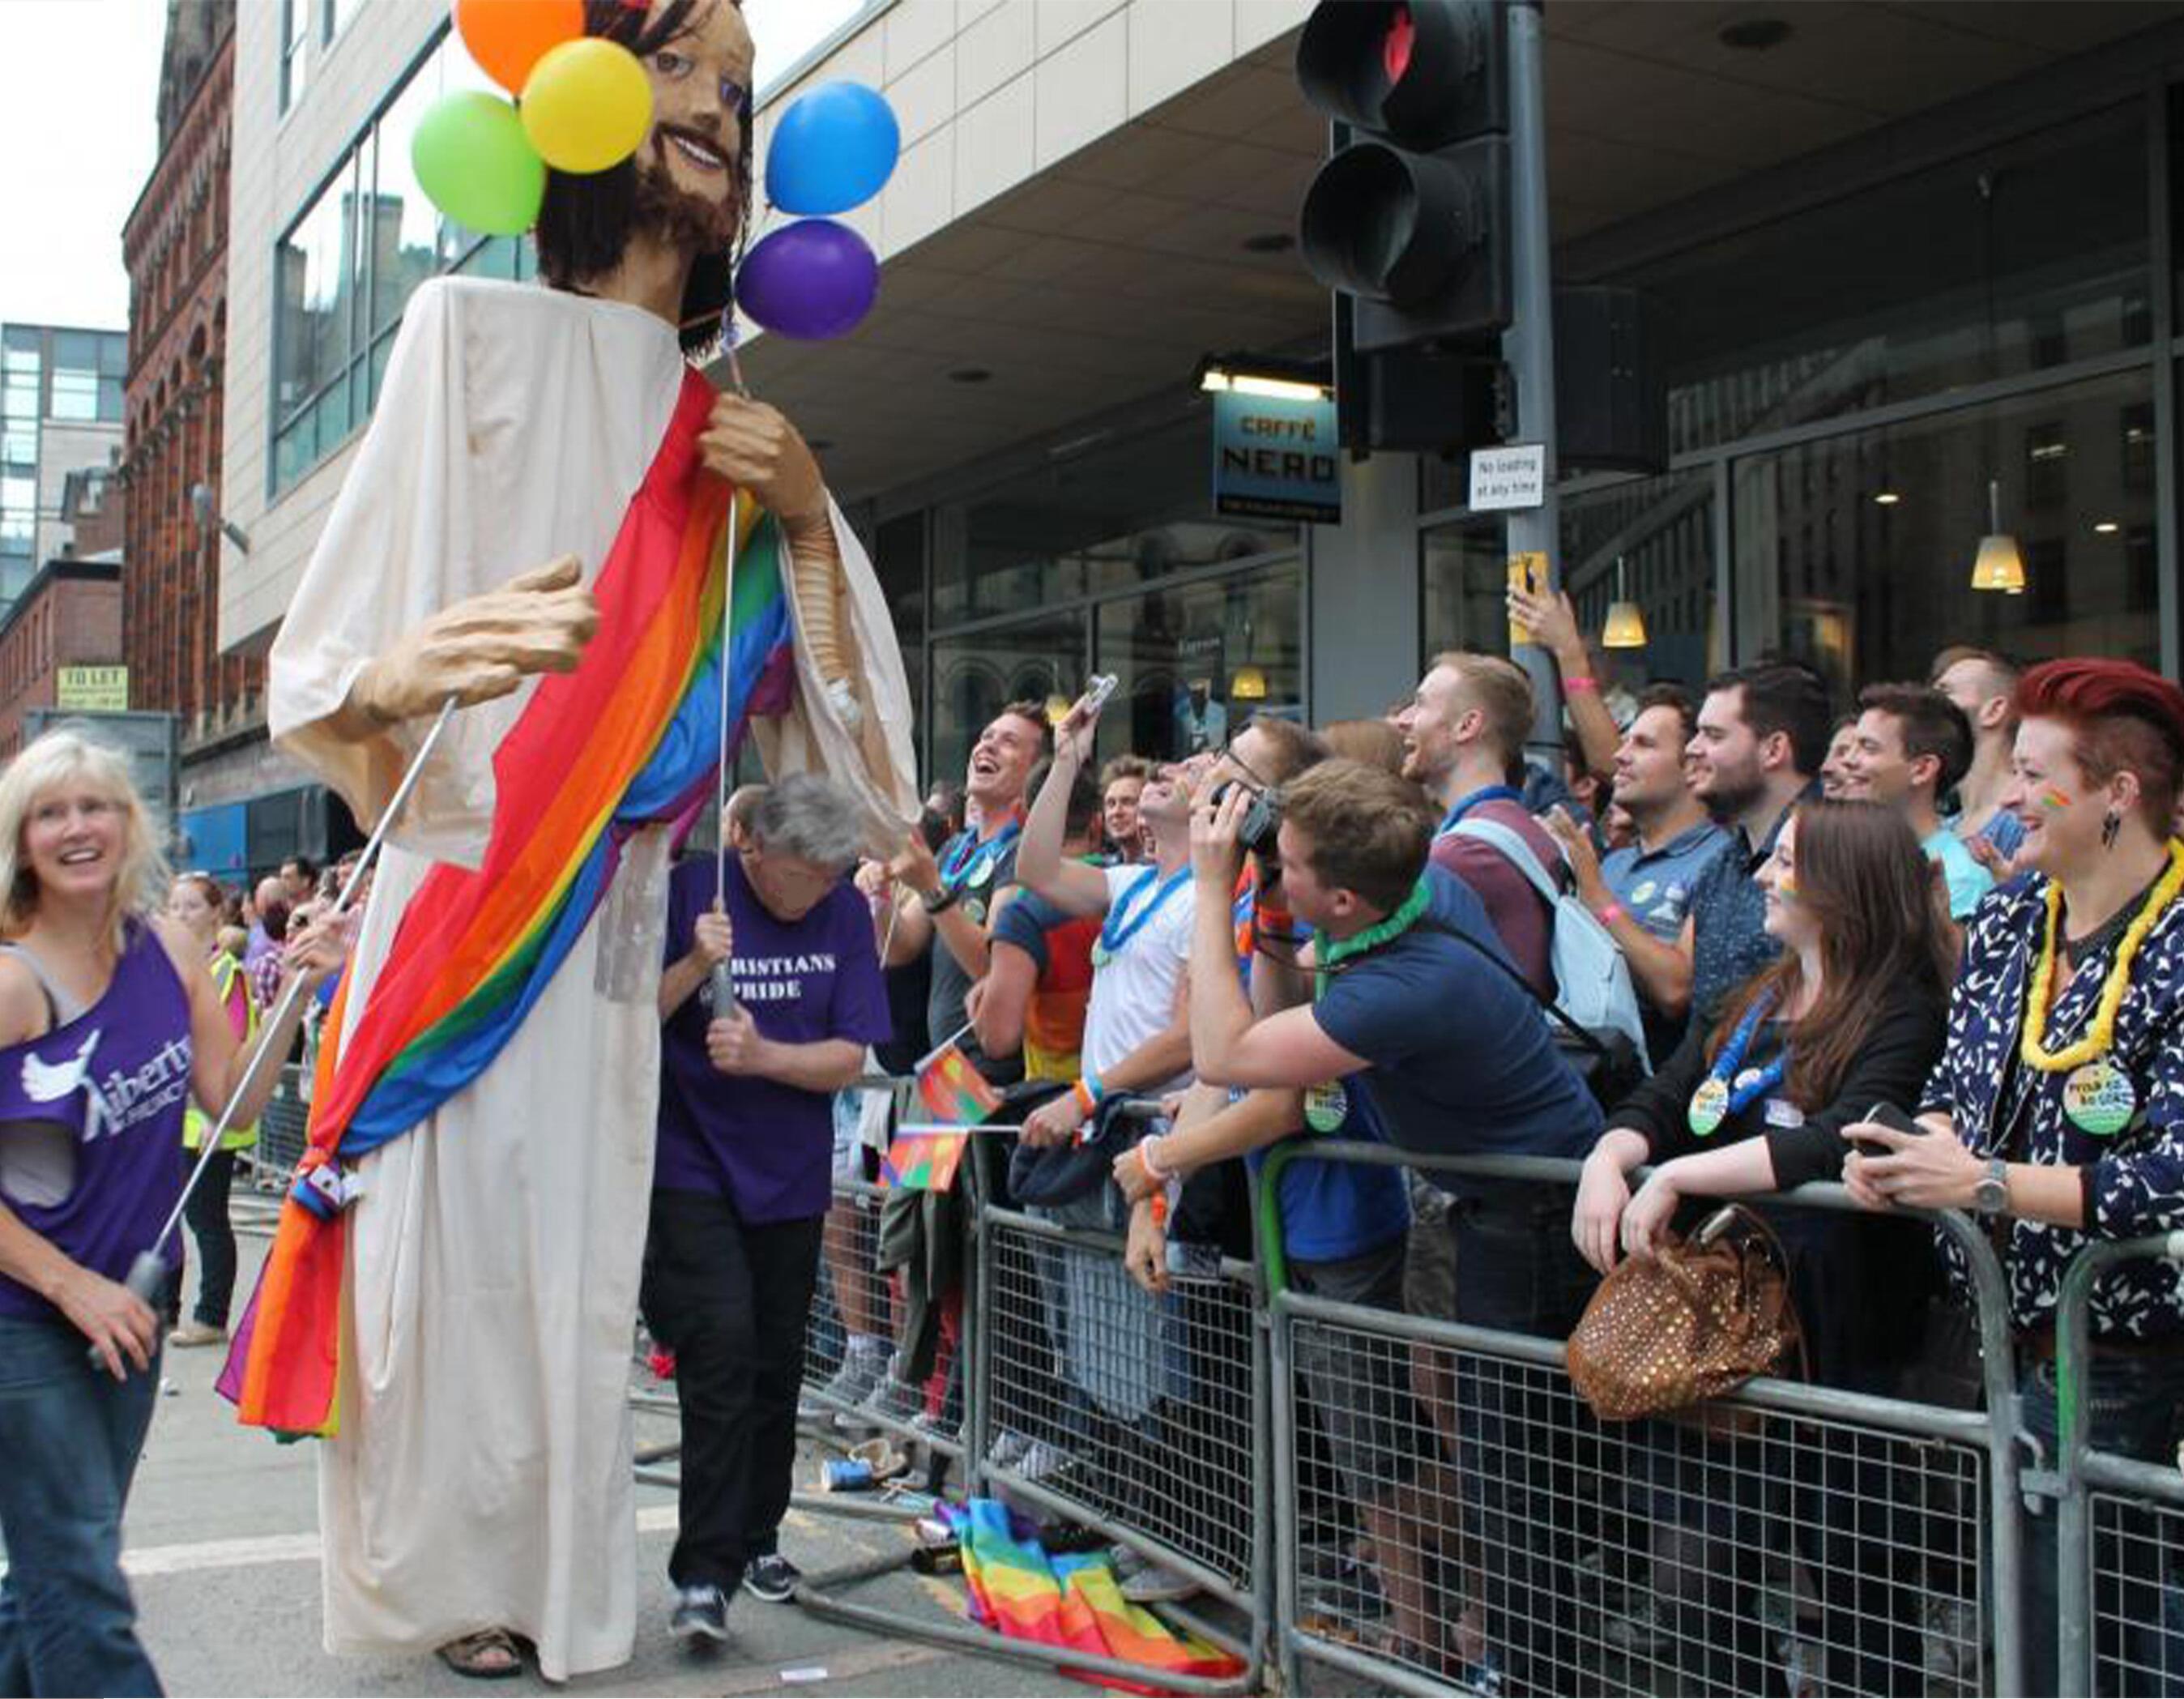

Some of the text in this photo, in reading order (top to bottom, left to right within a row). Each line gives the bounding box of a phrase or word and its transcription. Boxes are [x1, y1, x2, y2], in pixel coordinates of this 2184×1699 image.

[1223, 447, 1335, 482] NERO
[1479, 459, 1536, 474] No loading
[67, 669, 119, 685] TO LET
[731, 954, 835, 975] RISTIANS
